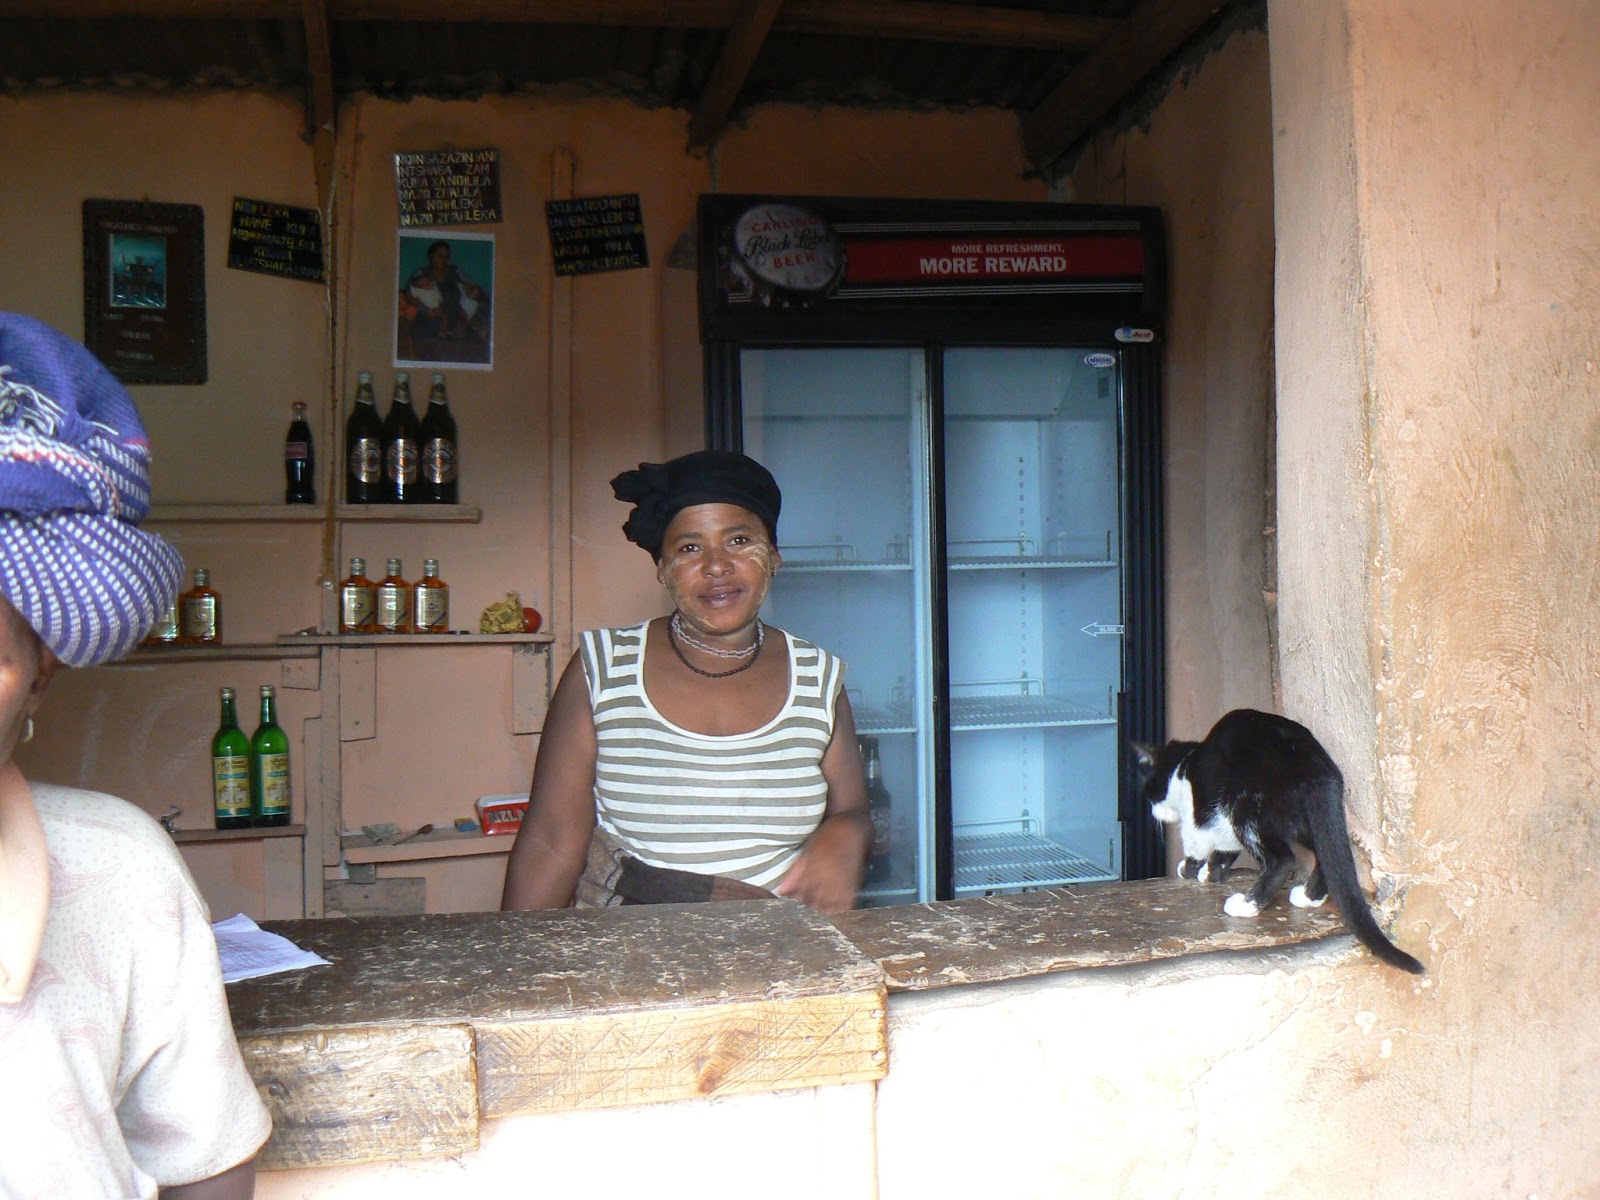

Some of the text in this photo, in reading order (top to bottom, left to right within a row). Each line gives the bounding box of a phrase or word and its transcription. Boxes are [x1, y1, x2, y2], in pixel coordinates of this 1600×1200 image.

[466, 163, 491, 175] ZAM
[399, 200, 416, 213] XA
[400, 212, 434, 227] NAZO
[743, 234, 791, 259] Black
[951, 243, 1066, 255] MORE REFRESHMENT,
[773, 252, 817, 269] BEER
[919, 256, 1068, 275] MORE REWARD
